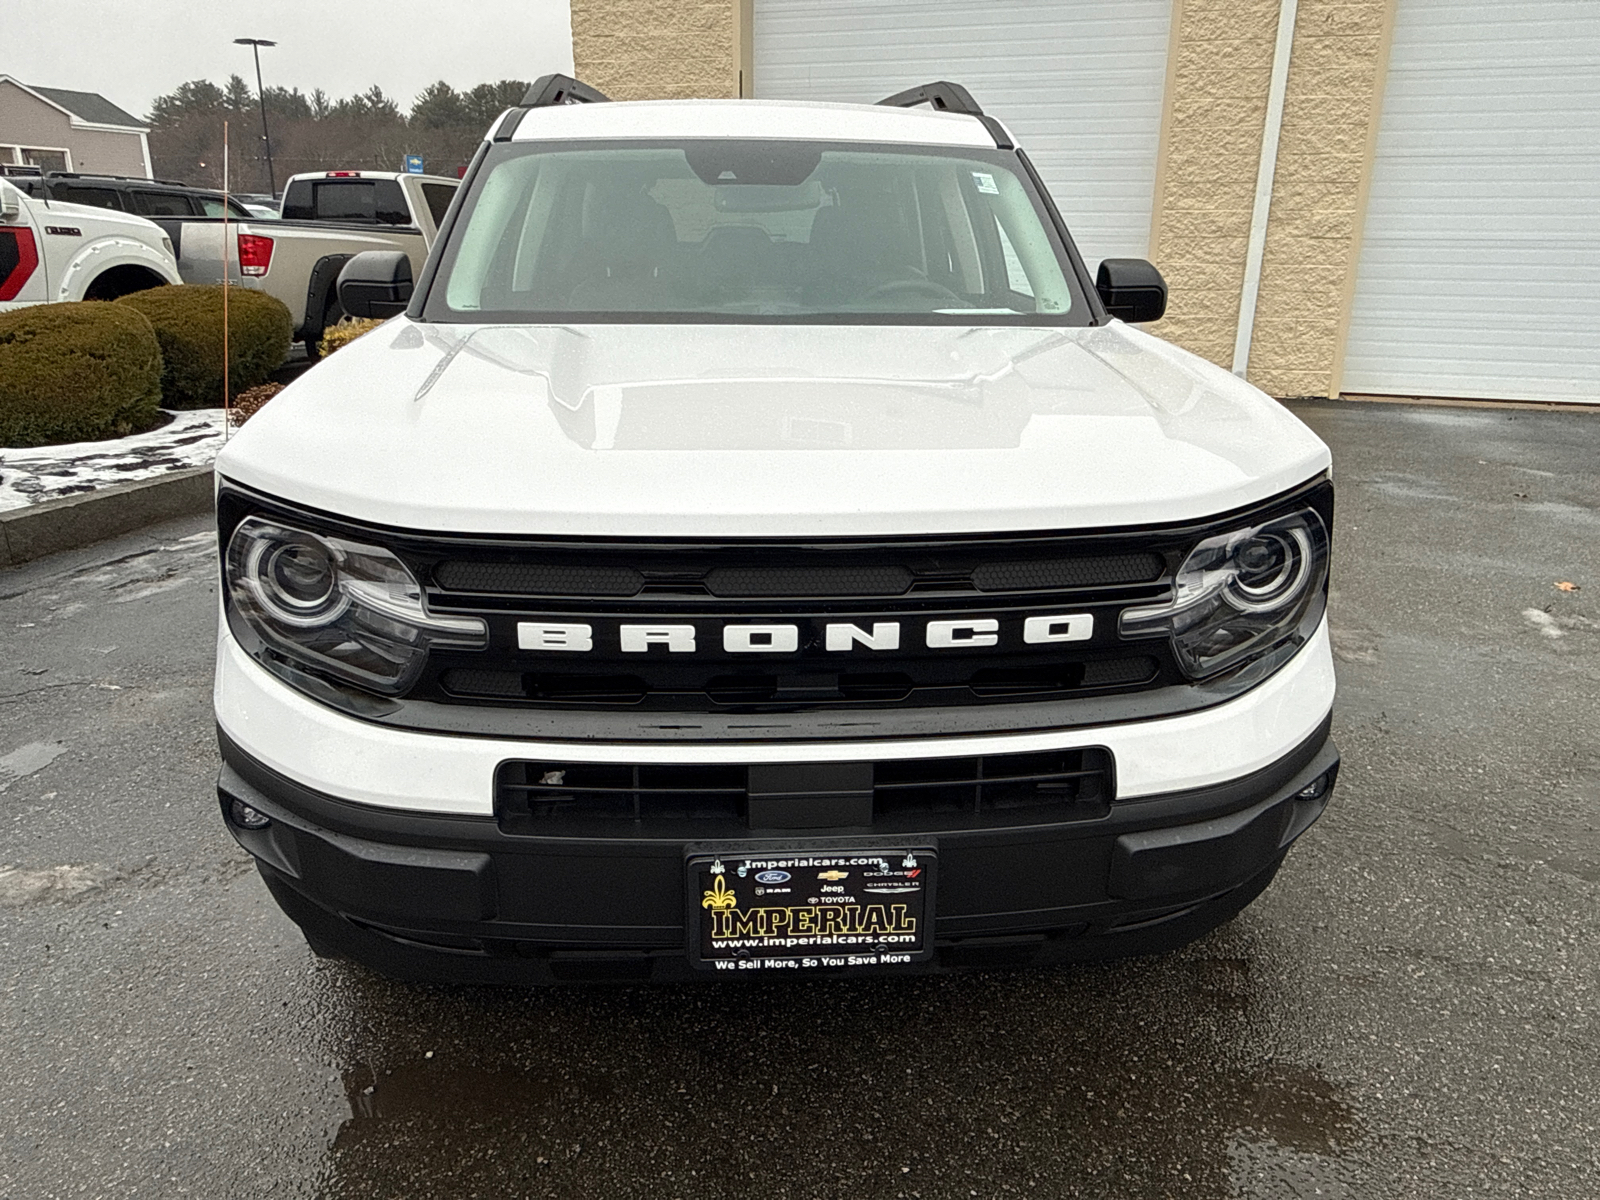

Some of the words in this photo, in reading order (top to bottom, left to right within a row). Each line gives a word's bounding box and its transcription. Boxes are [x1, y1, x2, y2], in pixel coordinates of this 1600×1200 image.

[517, 613, 1094, 653] BRONCO
[744, 857, 883, 869] Imperialcars.com
[820, 885, 844, 894] Jeep
[711, 904, 916, 938] IMPERIAL
[712, 935, 916, 948] www.imperialcars.com
[715, 960, 735, 970] We
[738, 960, 760, 969] Sell
[764, 959, 799, 969] More,
[802, 958, 818, 967] So
[821, 957, 845, 966] You
[847, 956, 877, 965] Save
[880, 954, 911, 964] More
